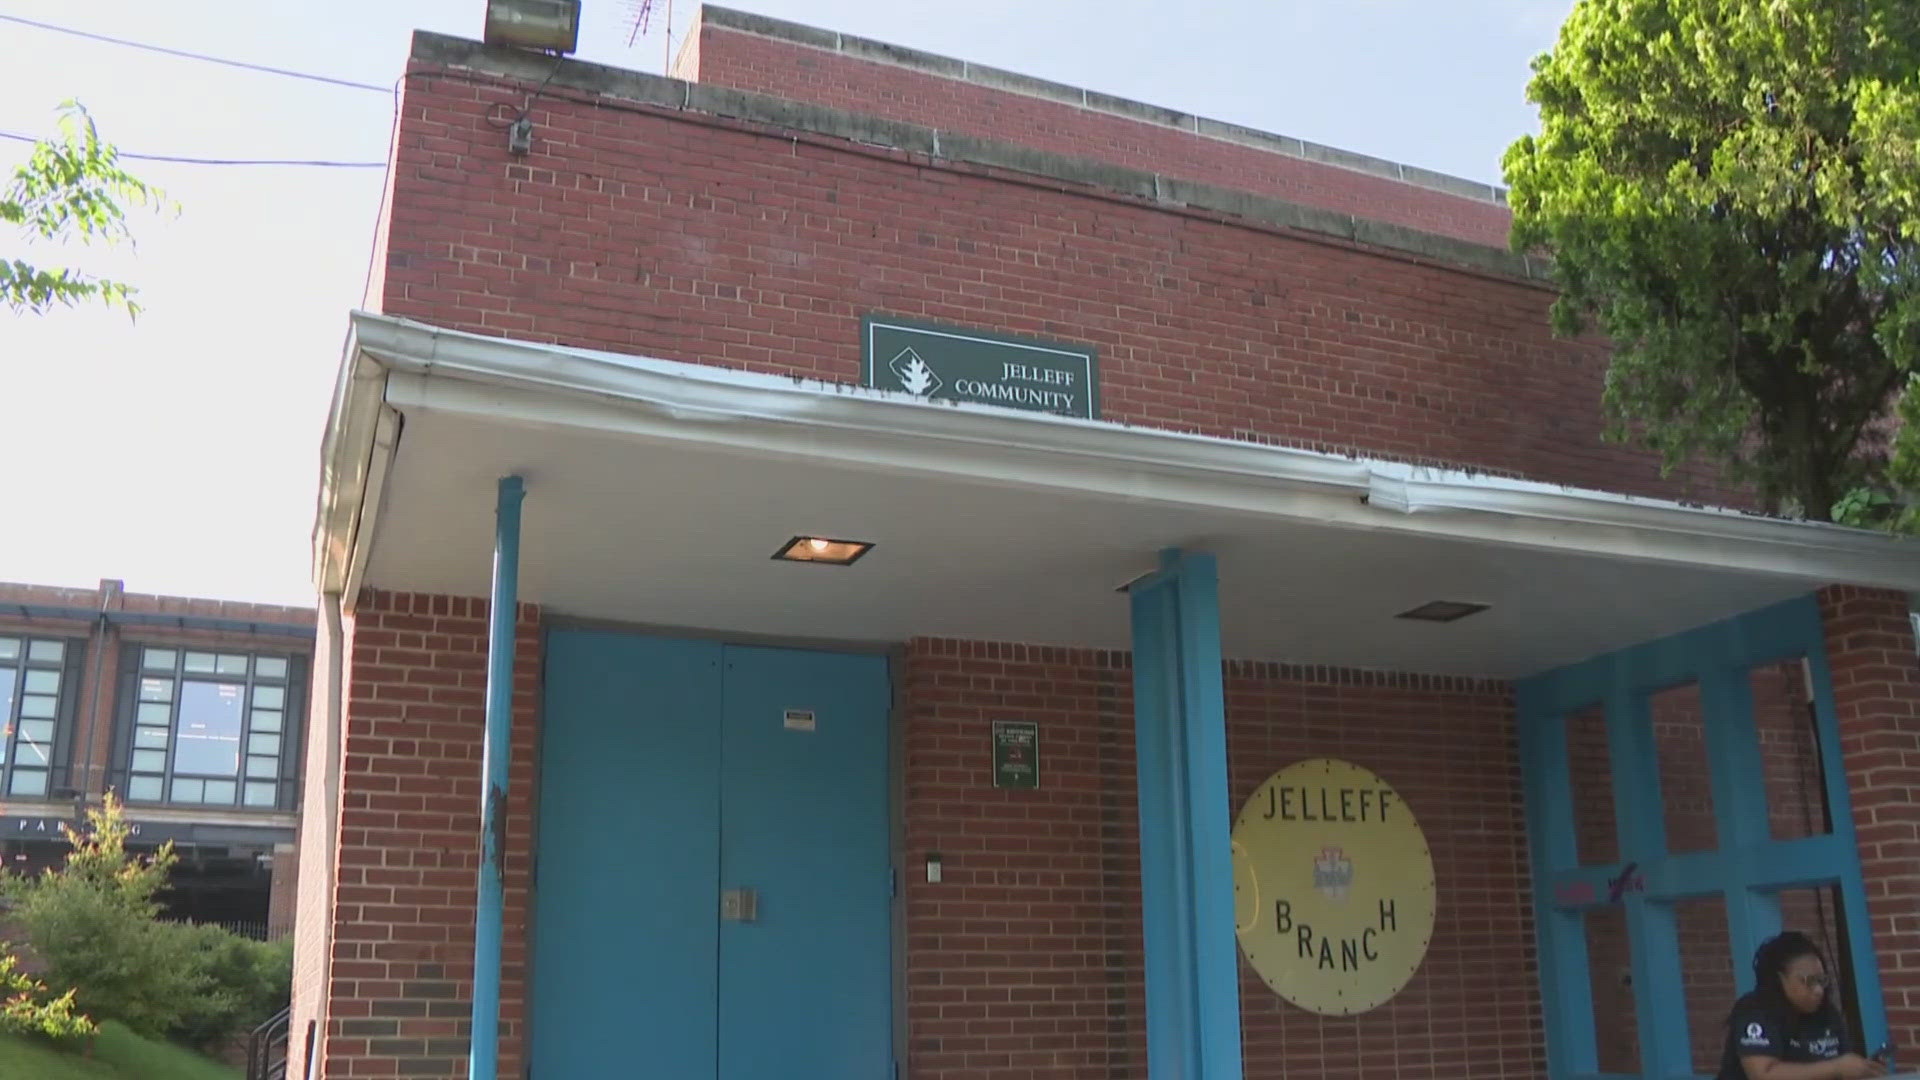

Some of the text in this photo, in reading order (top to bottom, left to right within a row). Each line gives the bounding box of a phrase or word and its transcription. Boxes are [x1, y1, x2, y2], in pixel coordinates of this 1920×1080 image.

[1002, 362, 1075, 386] JELLEFF
[954, 379, 1075, 409] COMMUNITY
[1263, 786, 1393, 822] JELLEFF
[19, 819, 141, 836] PARNG
[1275, 899, 1396, 972] BRANCH
